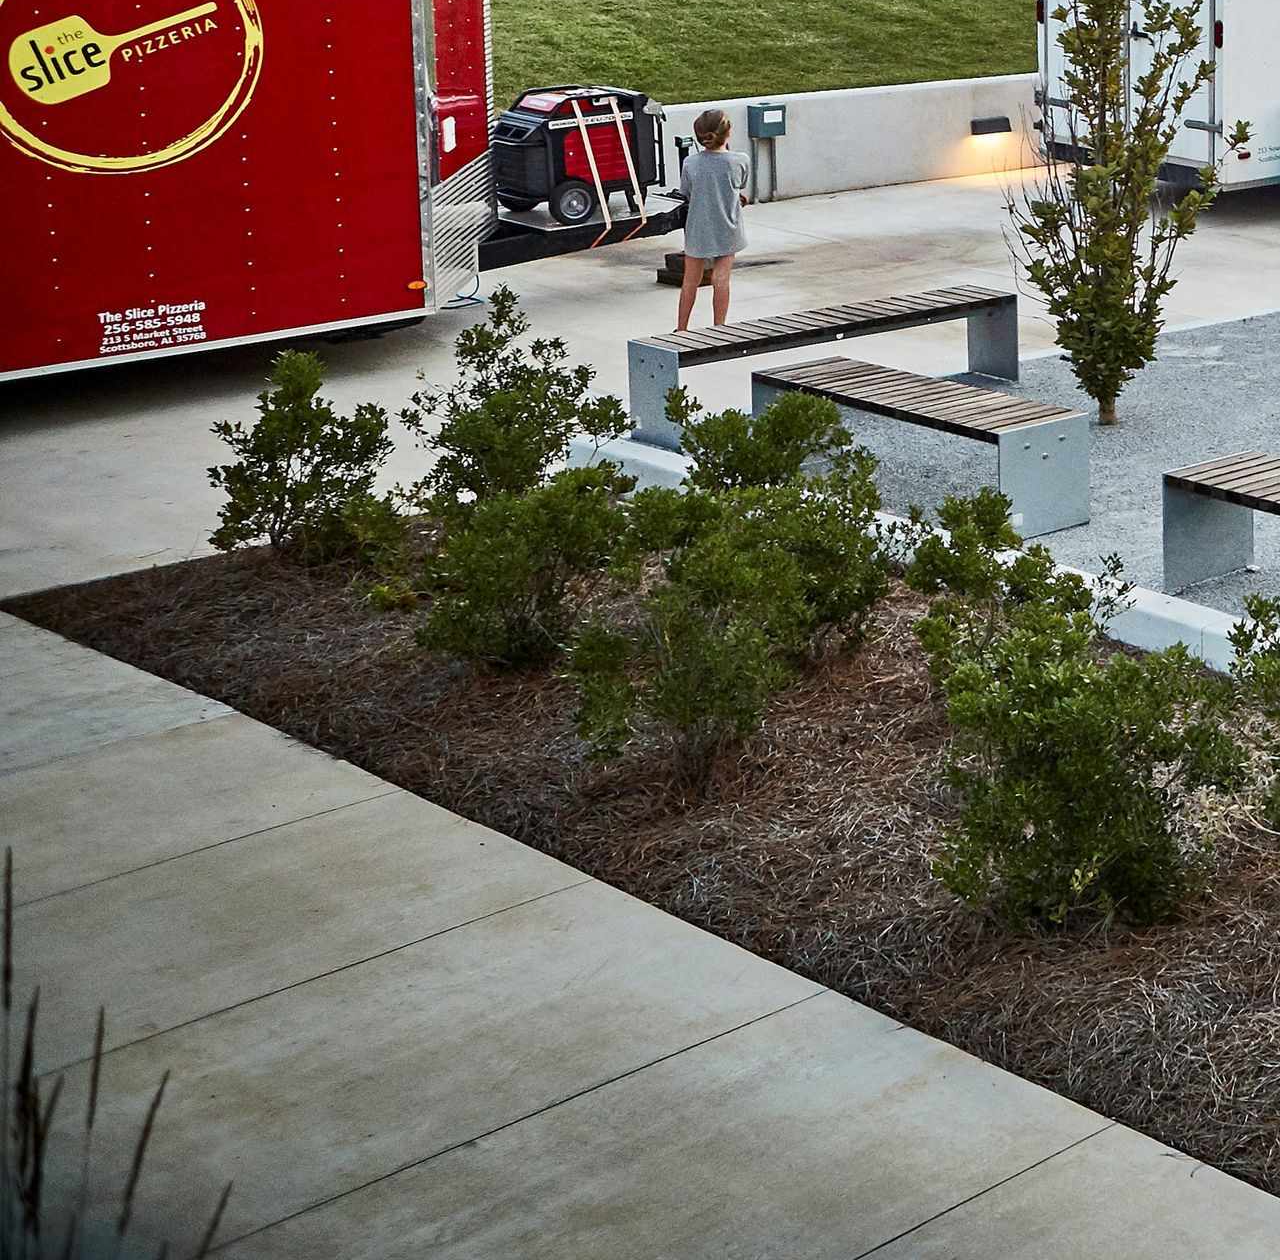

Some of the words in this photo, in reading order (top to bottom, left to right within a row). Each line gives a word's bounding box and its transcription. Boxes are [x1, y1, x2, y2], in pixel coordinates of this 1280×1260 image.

[56, 29, 84, 45] the
[121, 18, 218, 63] PIZZERIA
[20, 39, 107, 92] slice
[97, 311, 123, 324] The
[125, 307, 155, 321] Slice
[157, 300, 206, 316] Pizzeria
[102, 335, 122, 346] 213
[124, 334, 131, 342] S
[132, 329, 170, 341] Market
[172, 324, 203, 336] Street
[103, 313, 201, 335] 256-585-5948
[99, 340, 159, 354] Scottsboro,
[160, 337, 174, 345] AL
[176, 332, 207, 343] 35768
